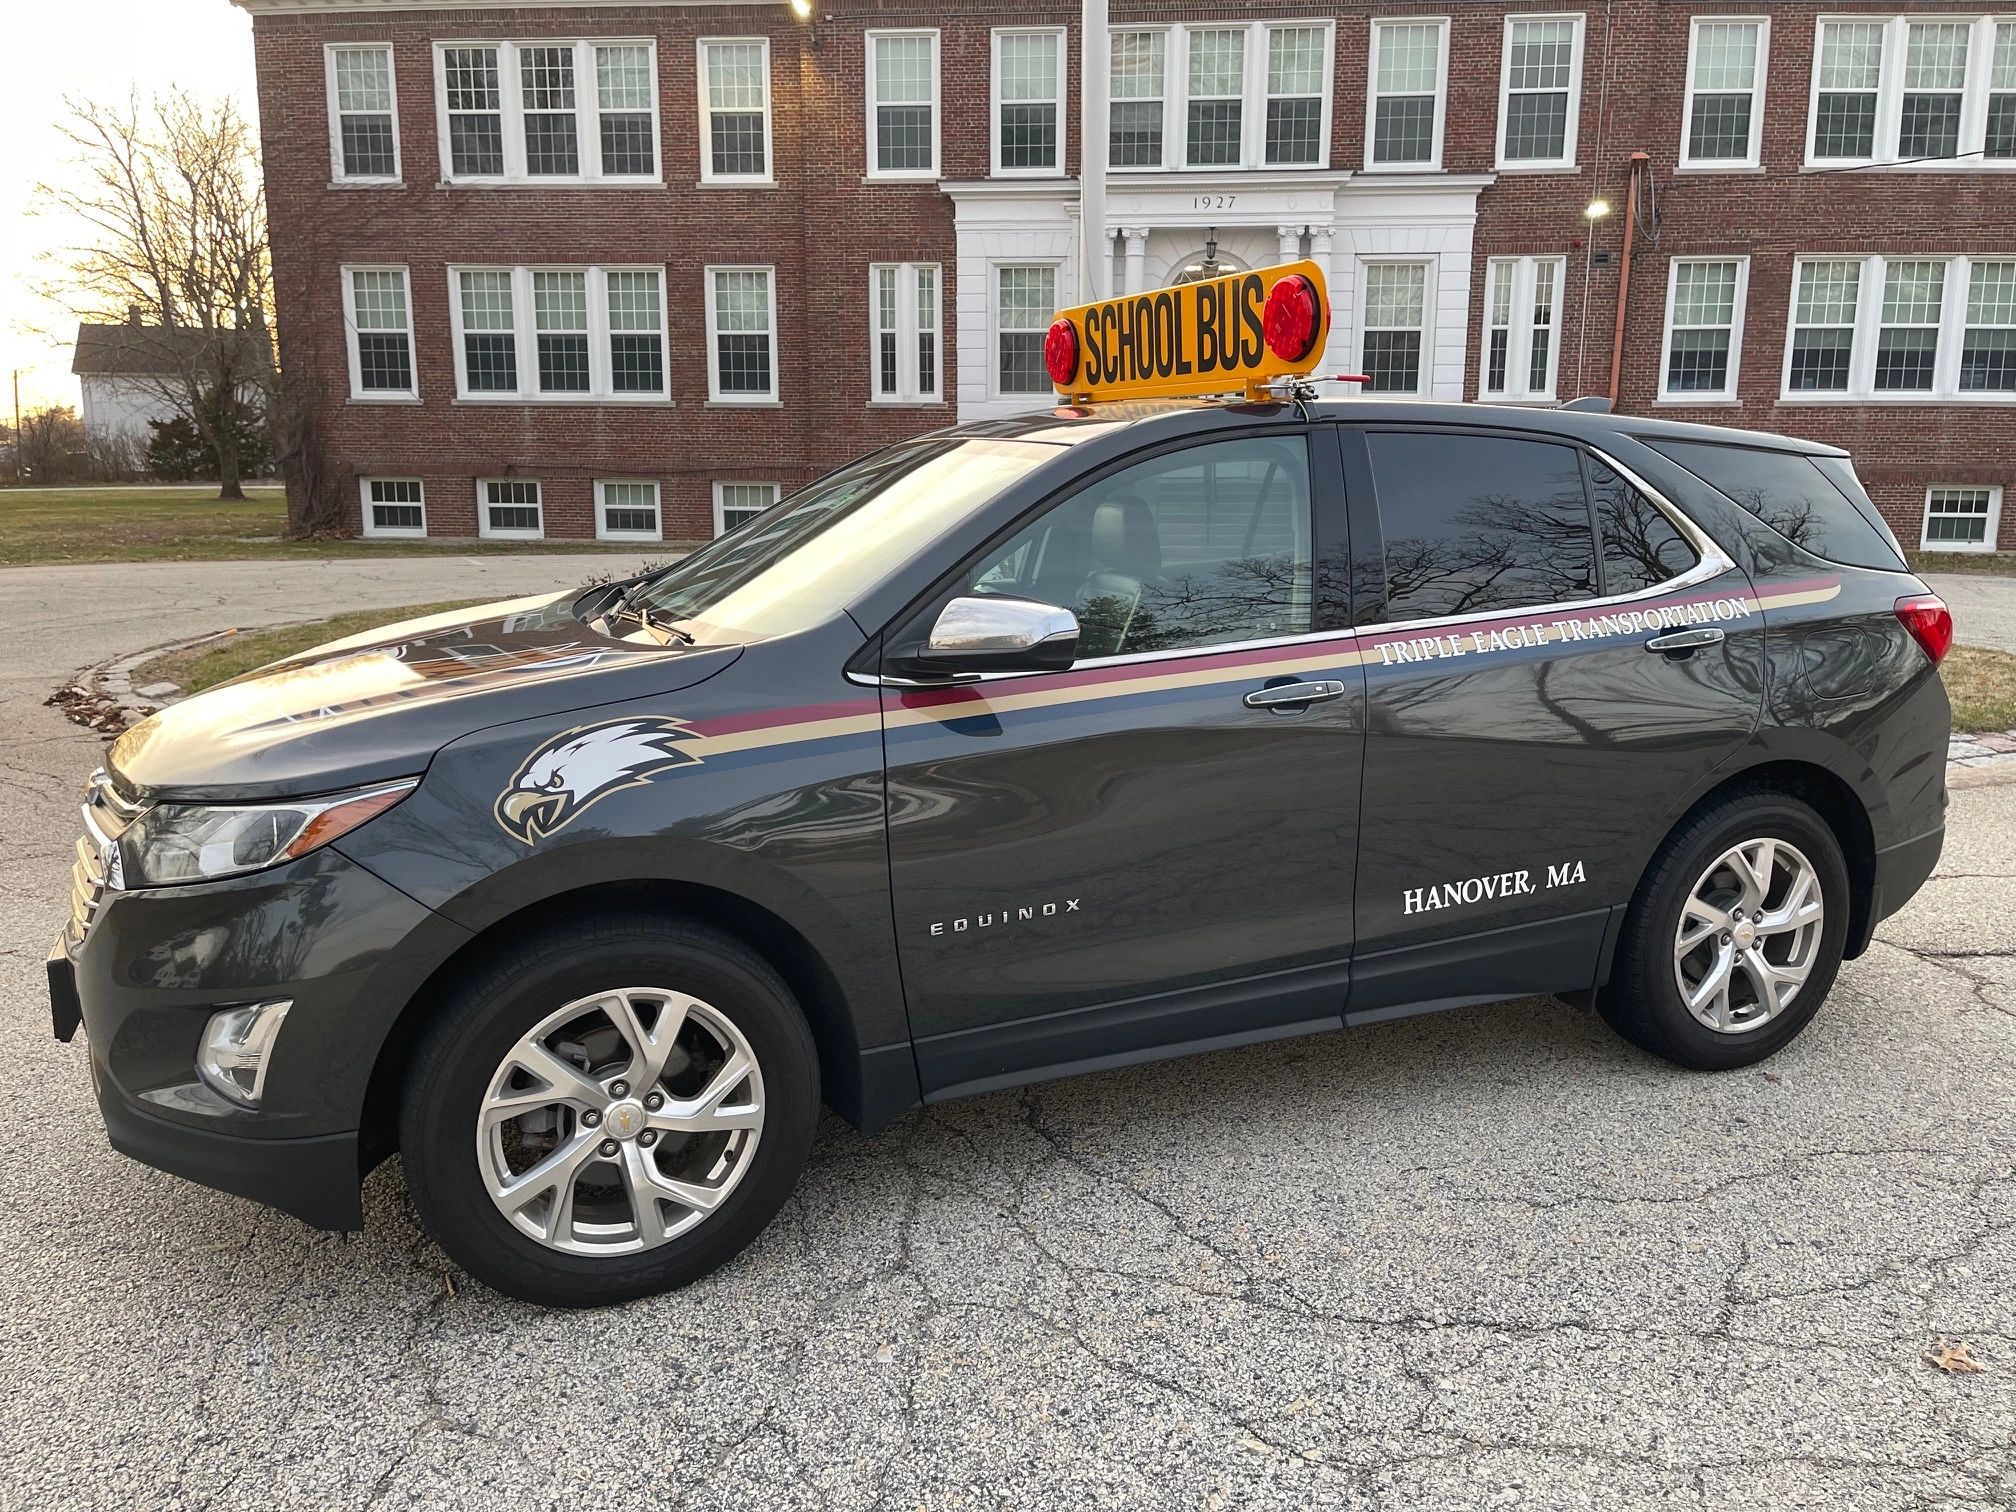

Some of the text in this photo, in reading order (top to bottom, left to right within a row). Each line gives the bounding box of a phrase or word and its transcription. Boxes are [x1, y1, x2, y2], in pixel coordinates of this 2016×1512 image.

[1194, 196, 1236, 209] 1927
[1085, 275, 1263, 385] SCHOOL BUS
[1374, 597, 1751, 666] TRIPLE EAGLE TRANSPORTATION
[1403, 860, 1586, 915] HANOVER, MA
[930, 898, 1080, 936] EQUINOX
